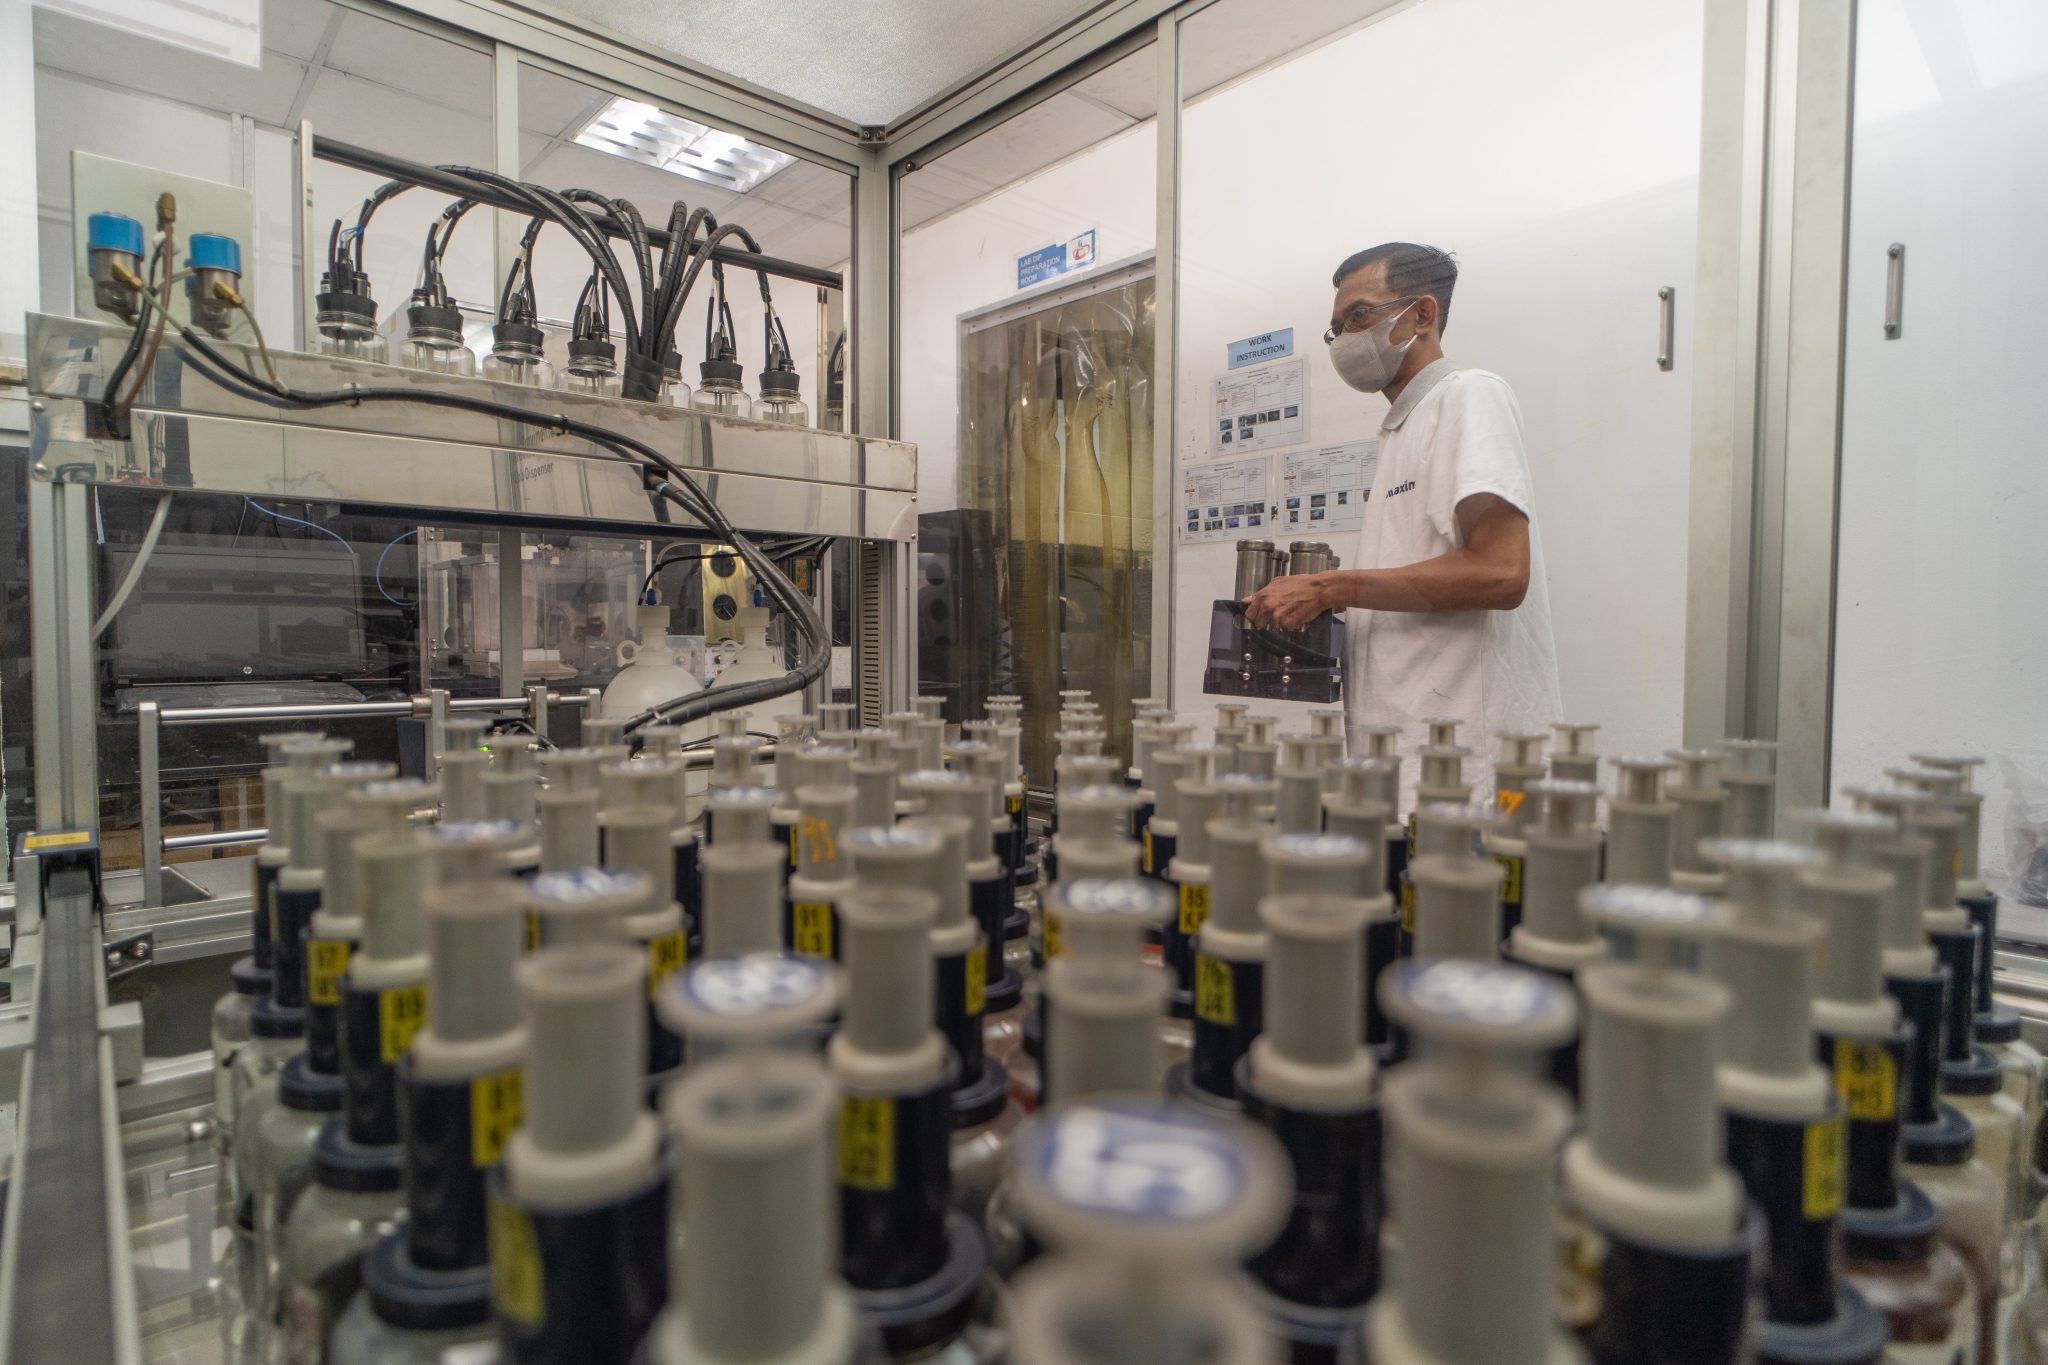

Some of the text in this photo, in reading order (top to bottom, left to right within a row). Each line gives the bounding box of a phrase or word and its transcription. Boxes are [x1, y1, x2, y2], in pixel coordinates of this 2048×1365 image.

[1021, 258, 1032, 267] LAB
[1021, 256, 1061, 277] PREPARATION
[1021, 273, 1038, 285] ROOM
[1248, 334, 1272, 347] WORK
[1237, 344, 1285, 362] INSTRUCTION
[525, 462, 554, 481] Dispenser
